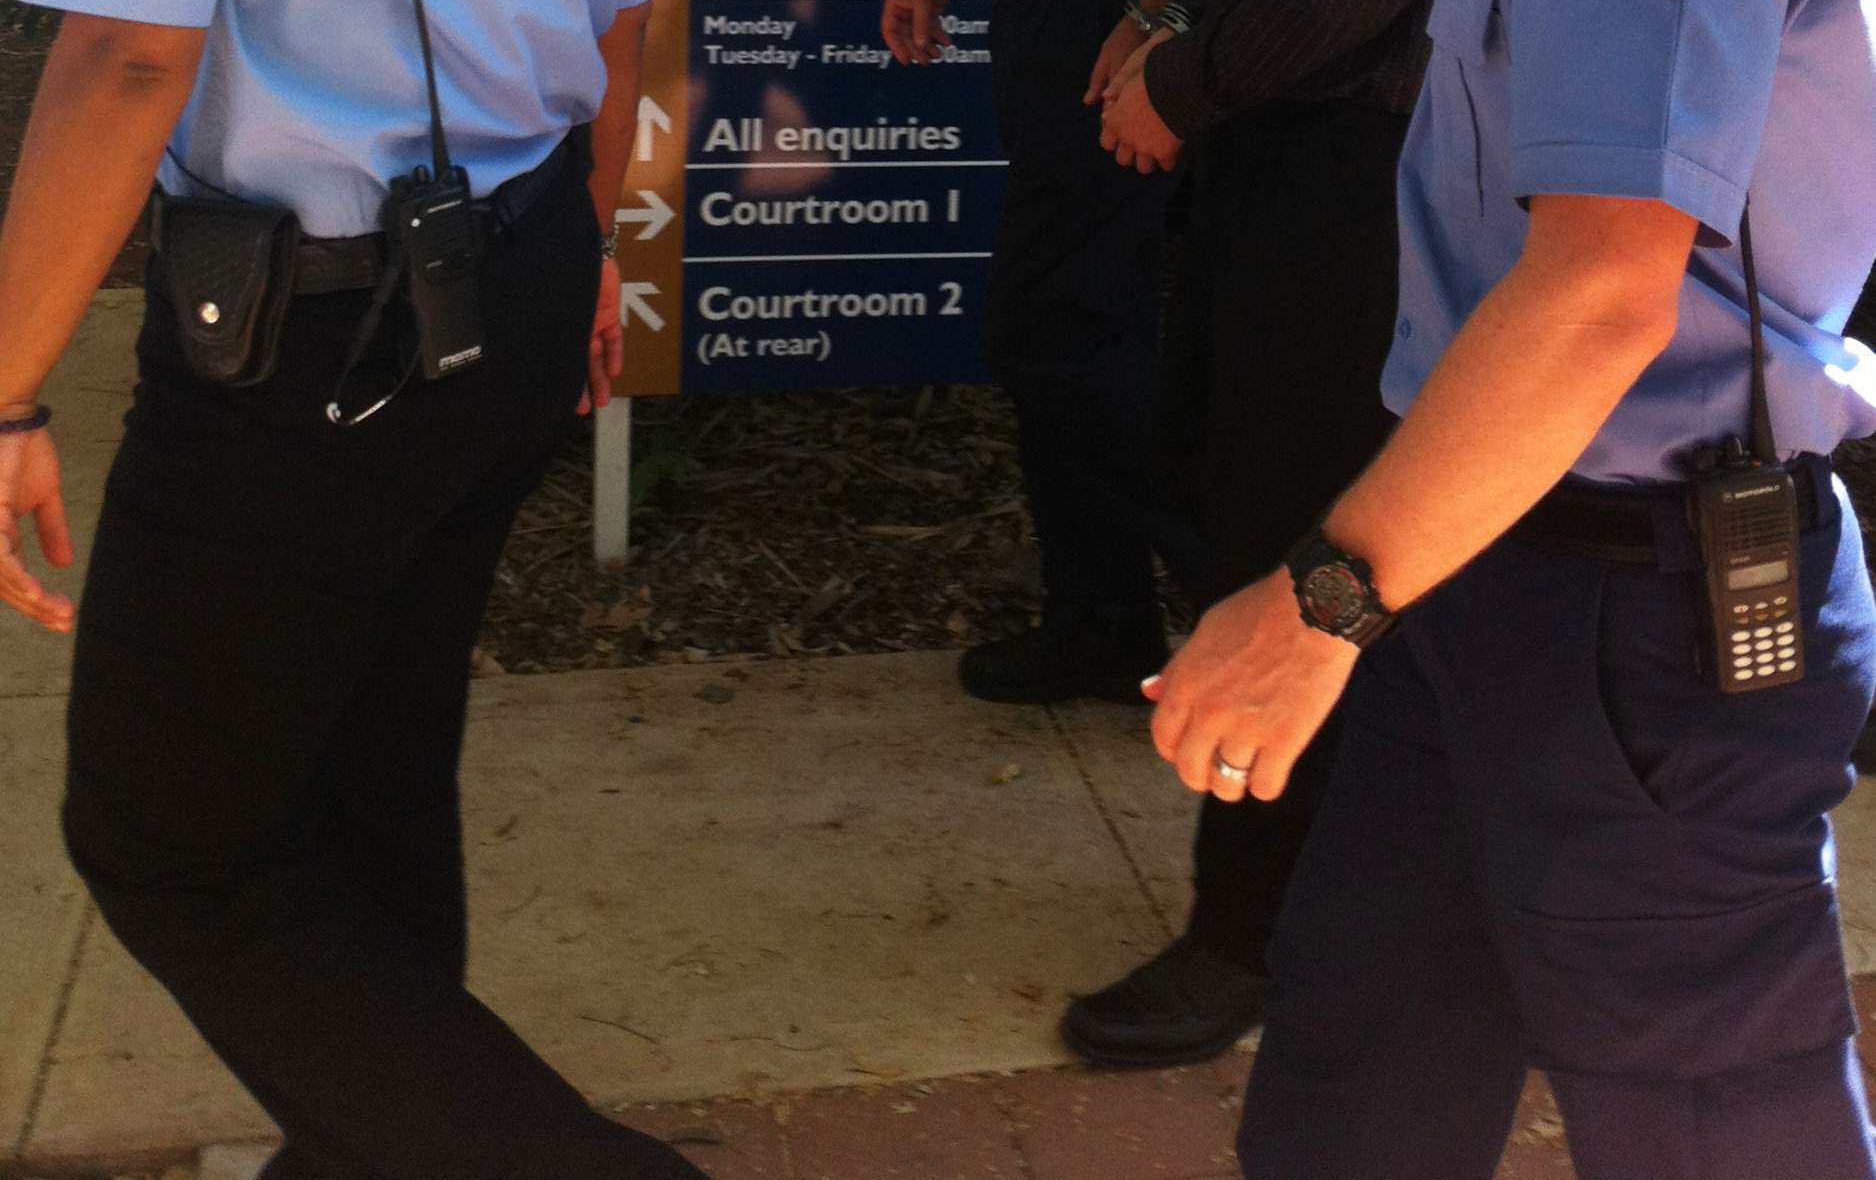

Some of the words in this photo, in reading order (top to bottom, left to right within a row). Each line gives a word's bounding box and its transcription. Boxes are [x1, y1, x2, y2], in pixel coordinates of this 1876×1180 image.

[704, 15, 797, 40] Monday
[704, 45, 800, 70] Tuesday
[821, 45, 892, 69] Friday
[704, 118, 763, 153] All
[774, 117, 961, 161] enquiries
[701, 192, 929, 227] Courtroom
[699, 286, 927, 320] Courtroom
[939, 282, 963, 315] 2
[698, 332, 748, 364] (At
[757, 330, 830, 361] rear)
